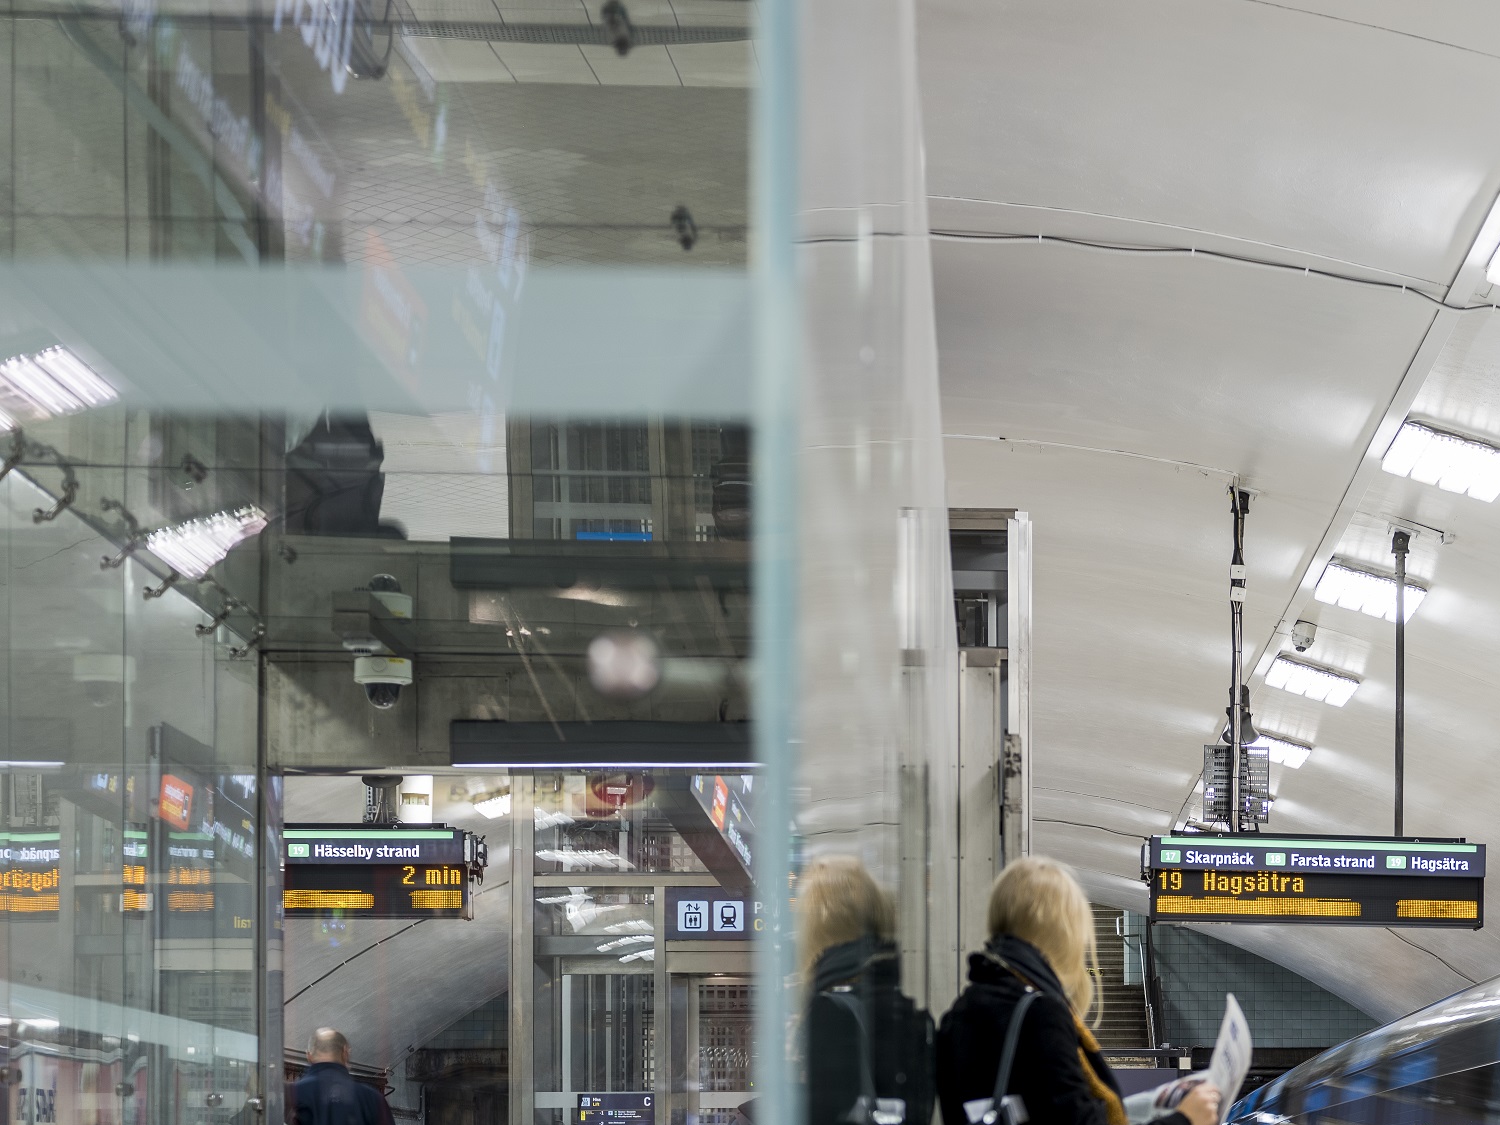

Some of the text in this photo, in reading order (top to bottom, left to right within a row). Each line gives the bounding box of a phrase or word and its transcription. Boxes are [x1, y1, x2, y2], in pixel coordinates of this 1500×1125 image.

[293, 844, 420, 860] 19 Hässelby strand
[1165, 850, 1469, 872] 17 Skarpnäck 18 Farsta strand 19 Hagsätra
[401, 865, 462, 886] 2 min
[1158, 869, 1304, 895] 19 Hagsätra
[643, 1096, 651, 1107] C
